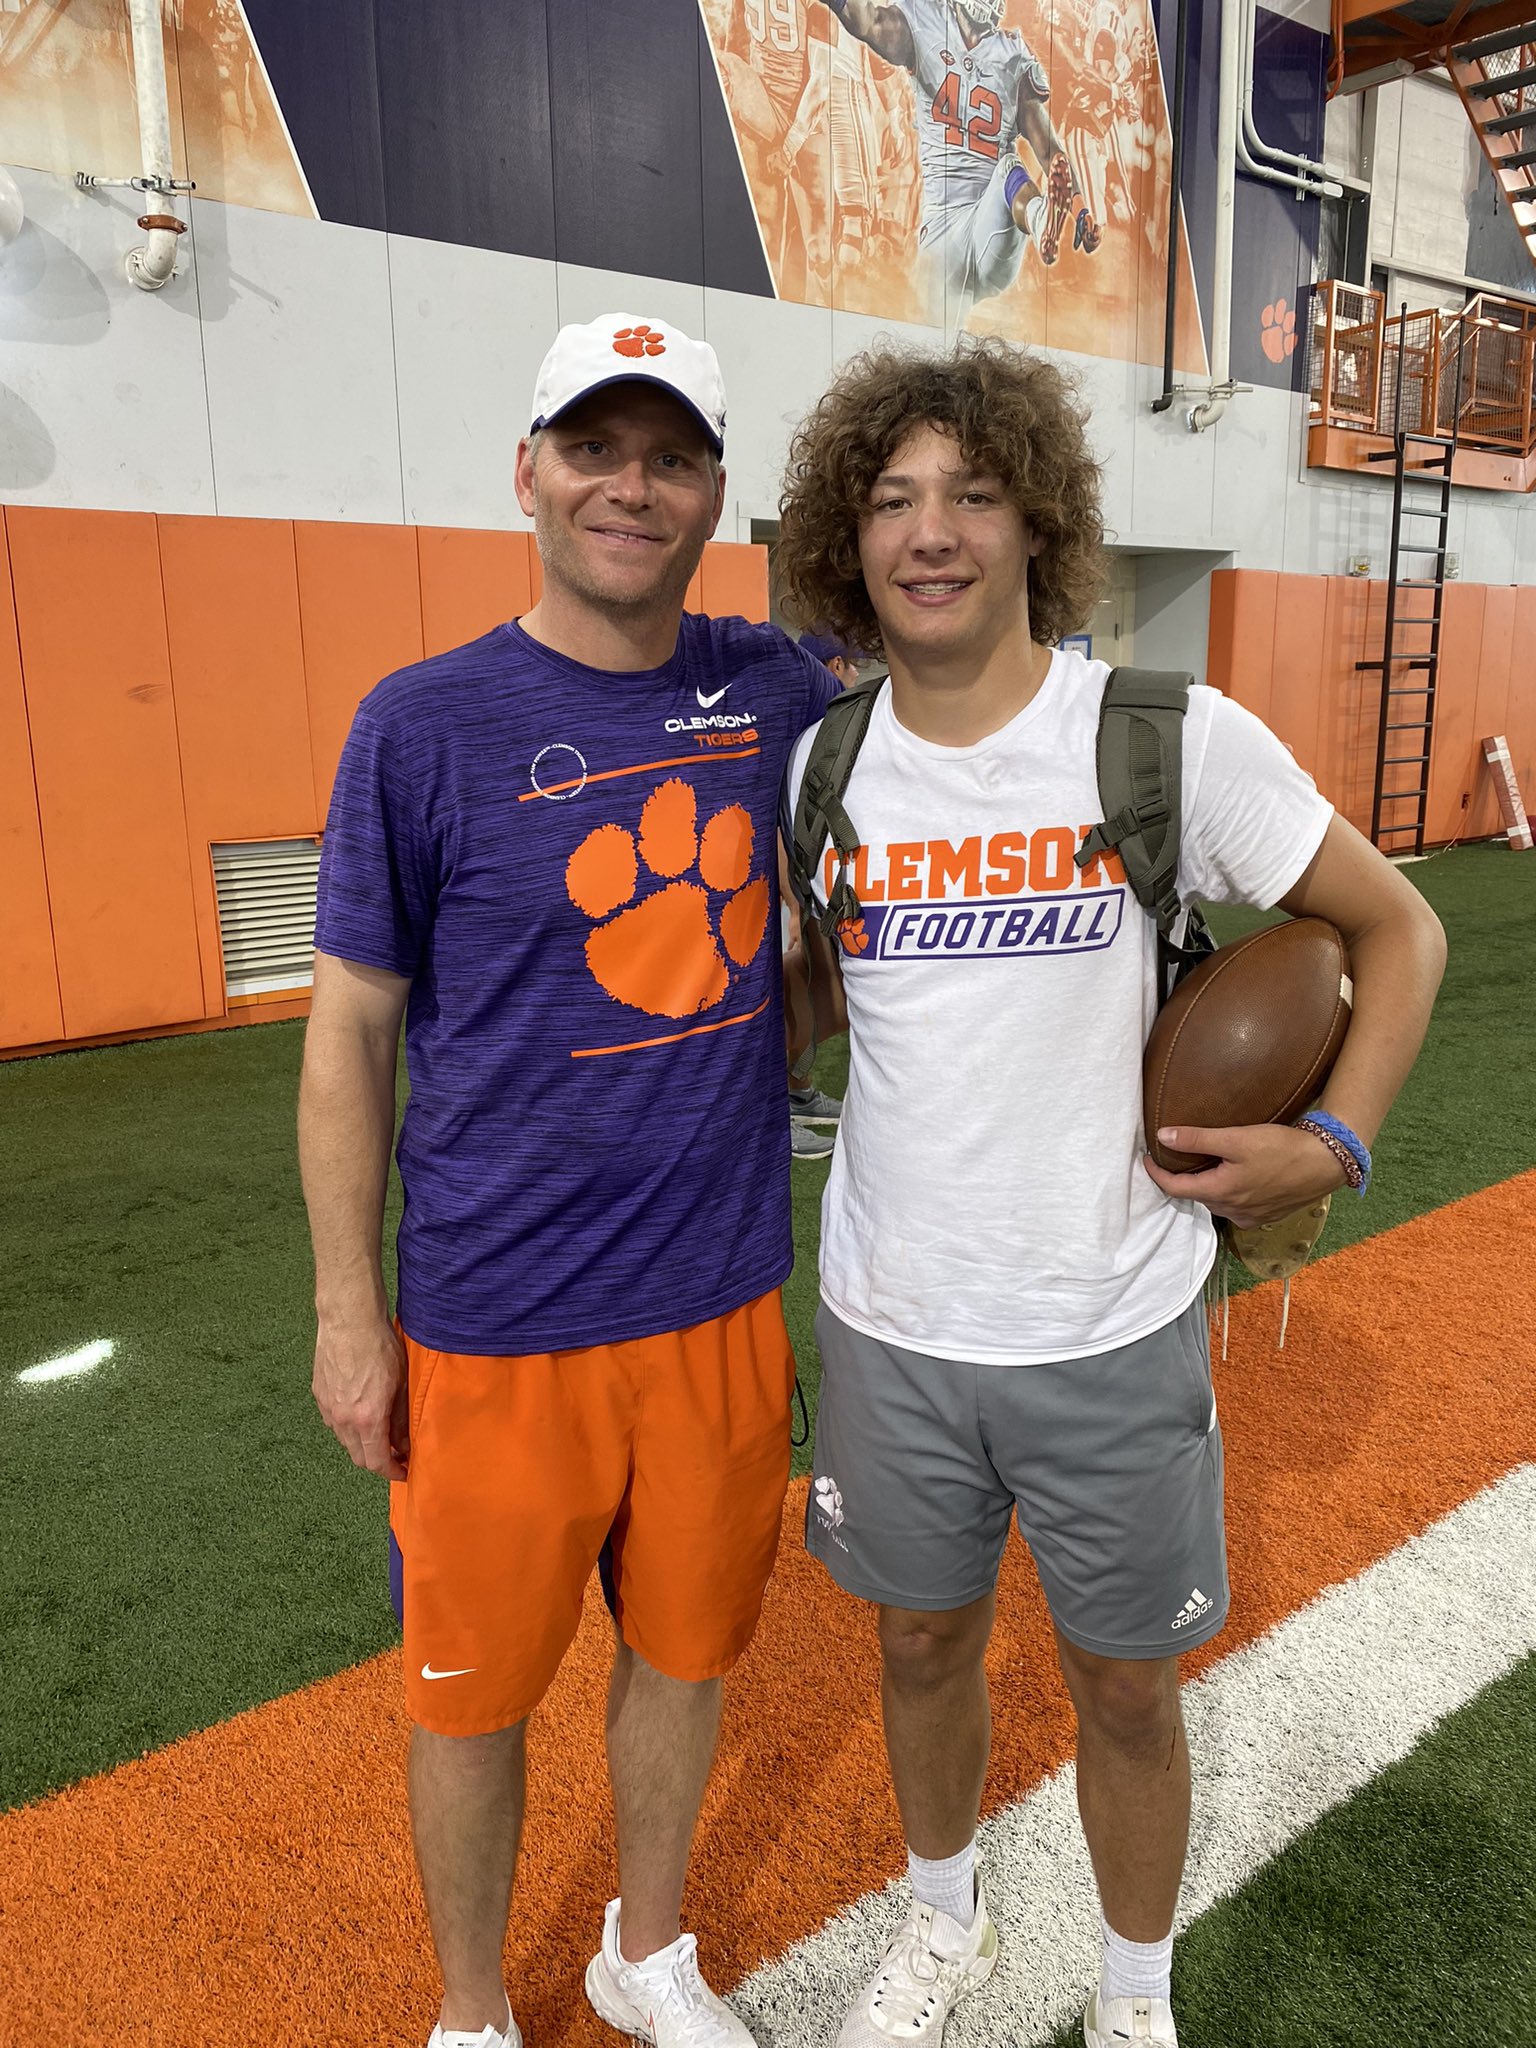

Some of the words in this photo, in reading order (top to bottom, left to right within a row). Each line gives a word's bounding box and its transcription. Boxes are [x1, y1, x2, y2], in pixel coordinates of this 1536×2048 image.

[932, 71, 1002, 160] 42
[694, 728, 759, 747] TIGERS
[894, 902, 1108, 950] FOOTBALL
[1171, 1598, 1213, 1630] adidas
